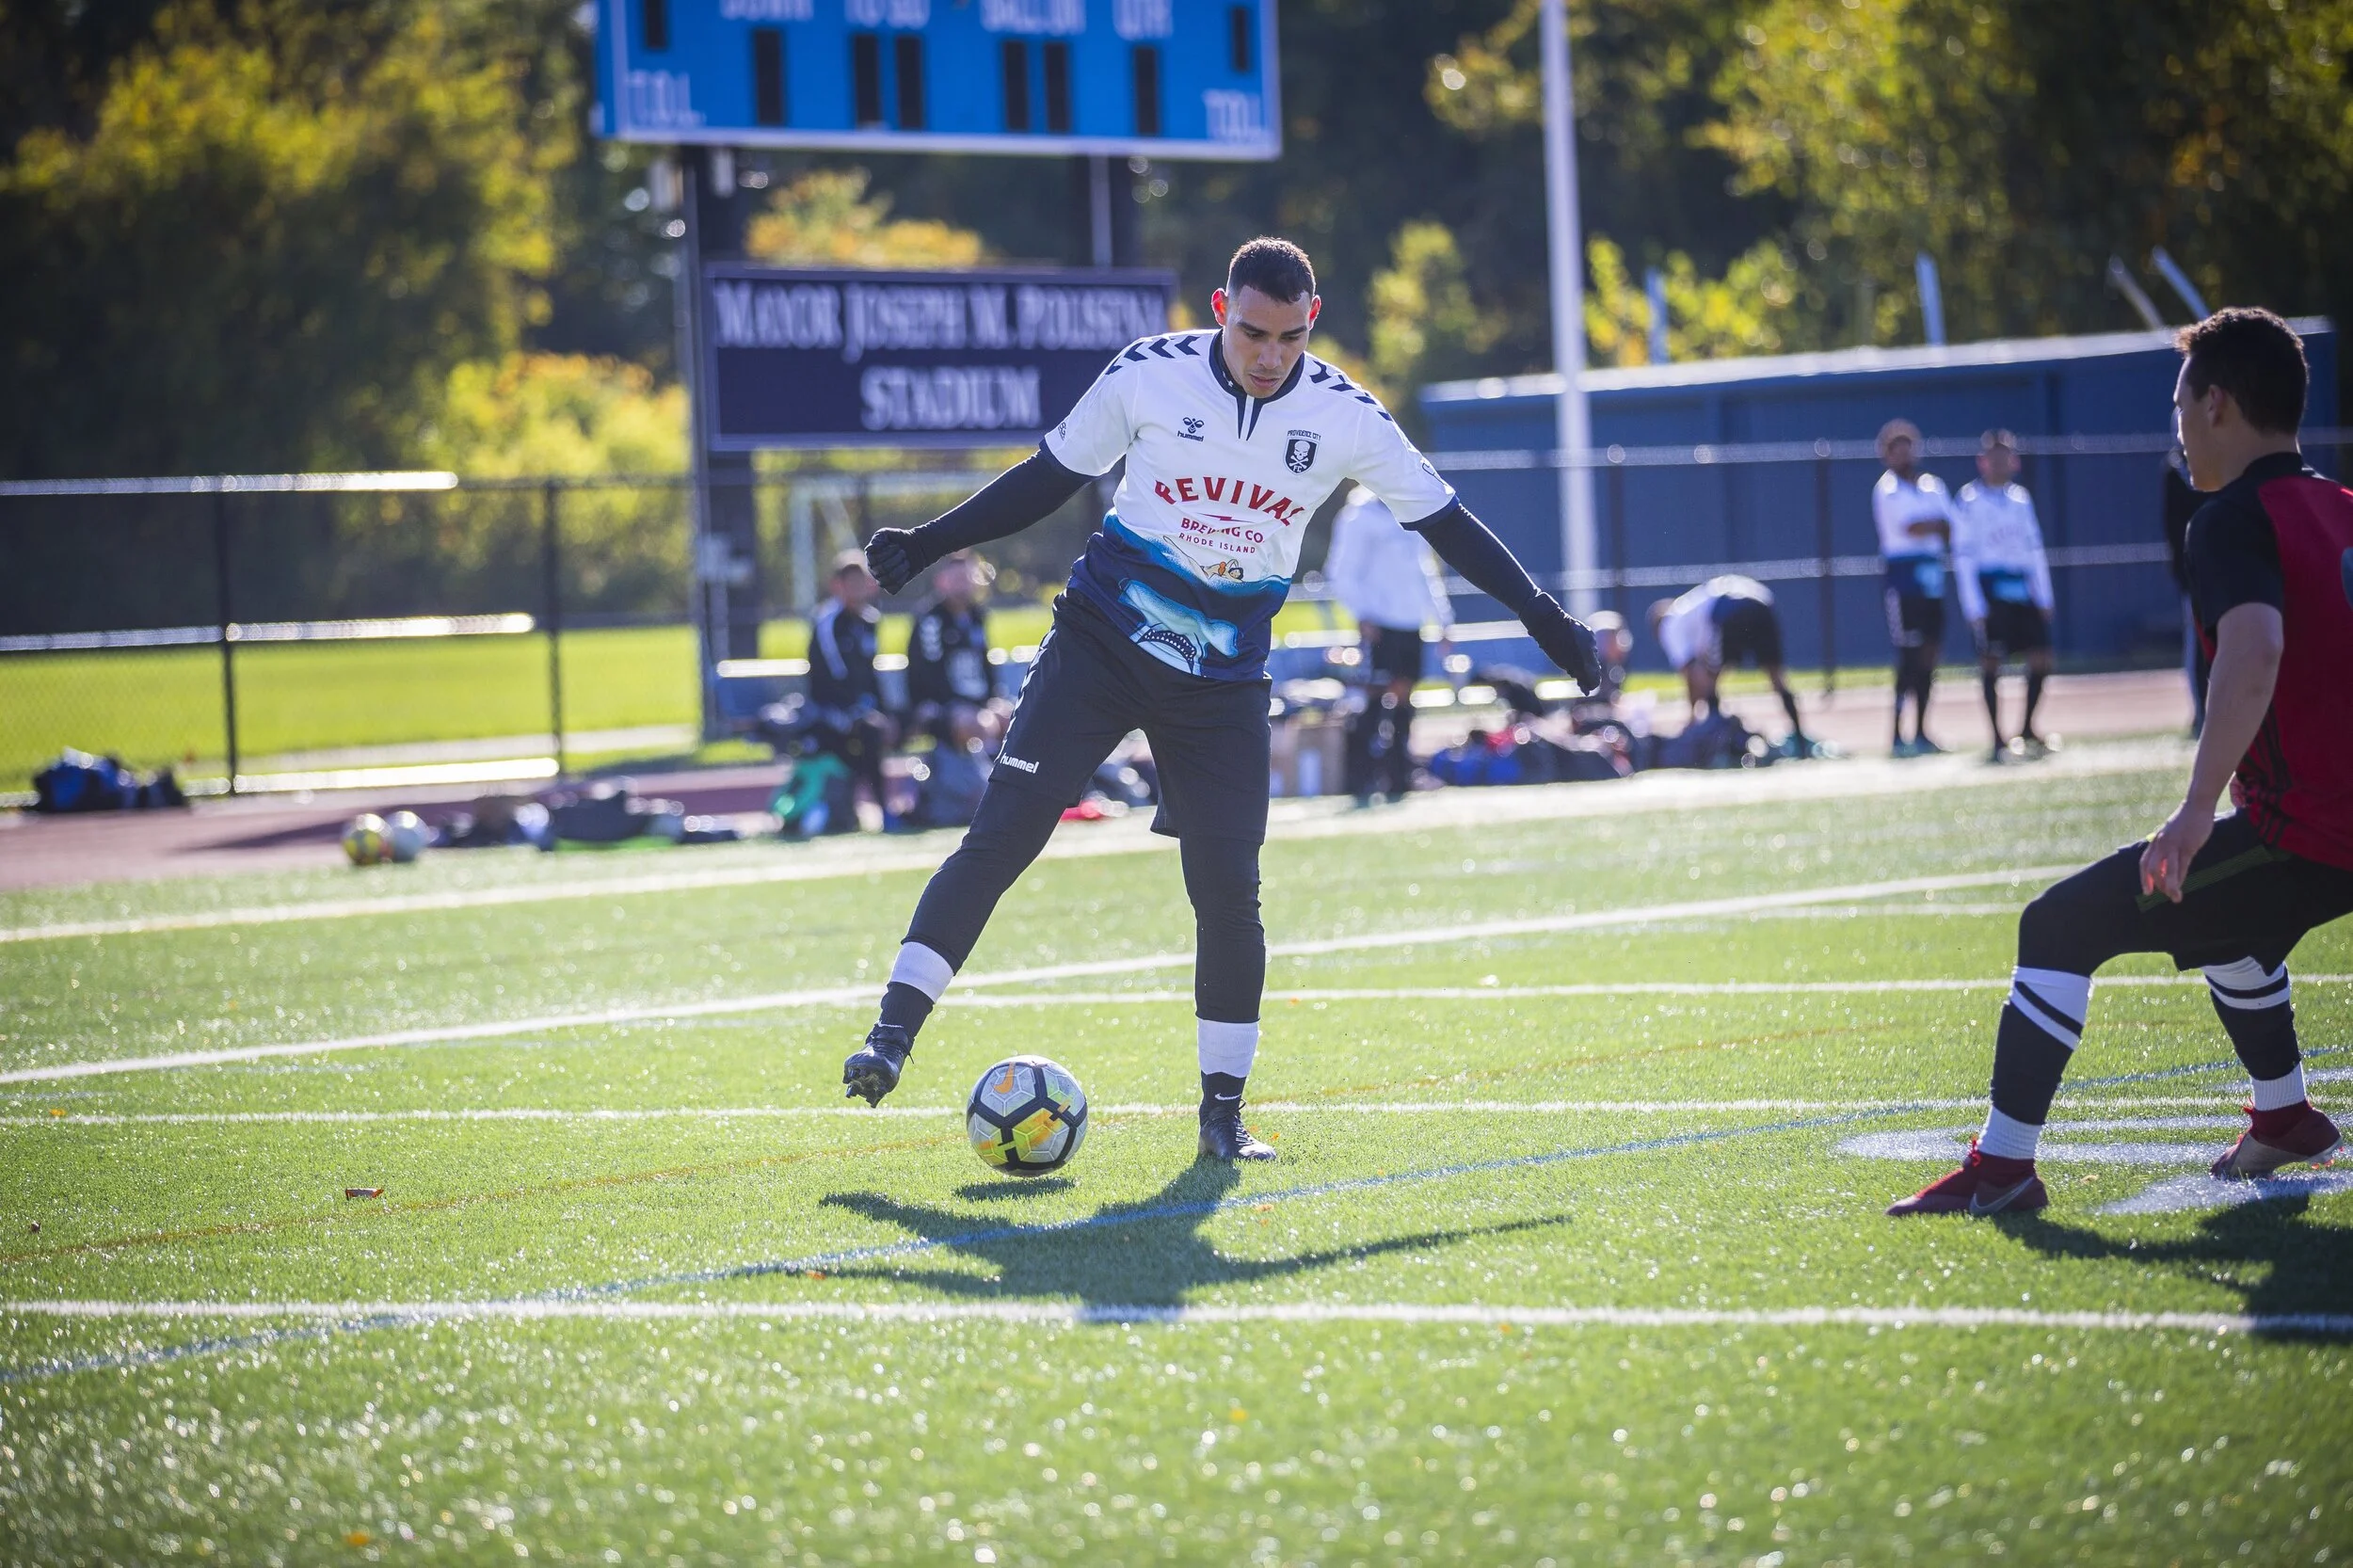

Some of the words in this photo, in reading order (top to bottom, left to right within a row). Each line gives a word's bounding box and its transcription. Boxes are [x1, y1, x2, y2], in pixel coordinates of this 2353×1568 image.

[717, 282, 842, 347] MAYOR
[843, 284, 965, 361] JOSEPH
[860, 367, 1042, 429] STADIUM
[1177, 430, 1204, 441] hummel
[1154, 476, 1305, 526] REVIVAL
[1178, 533, 1213, 547] RHODE
[1220, 542, 1256, 553] ISLAND
[1000, 752, 1039, 774] hummel
